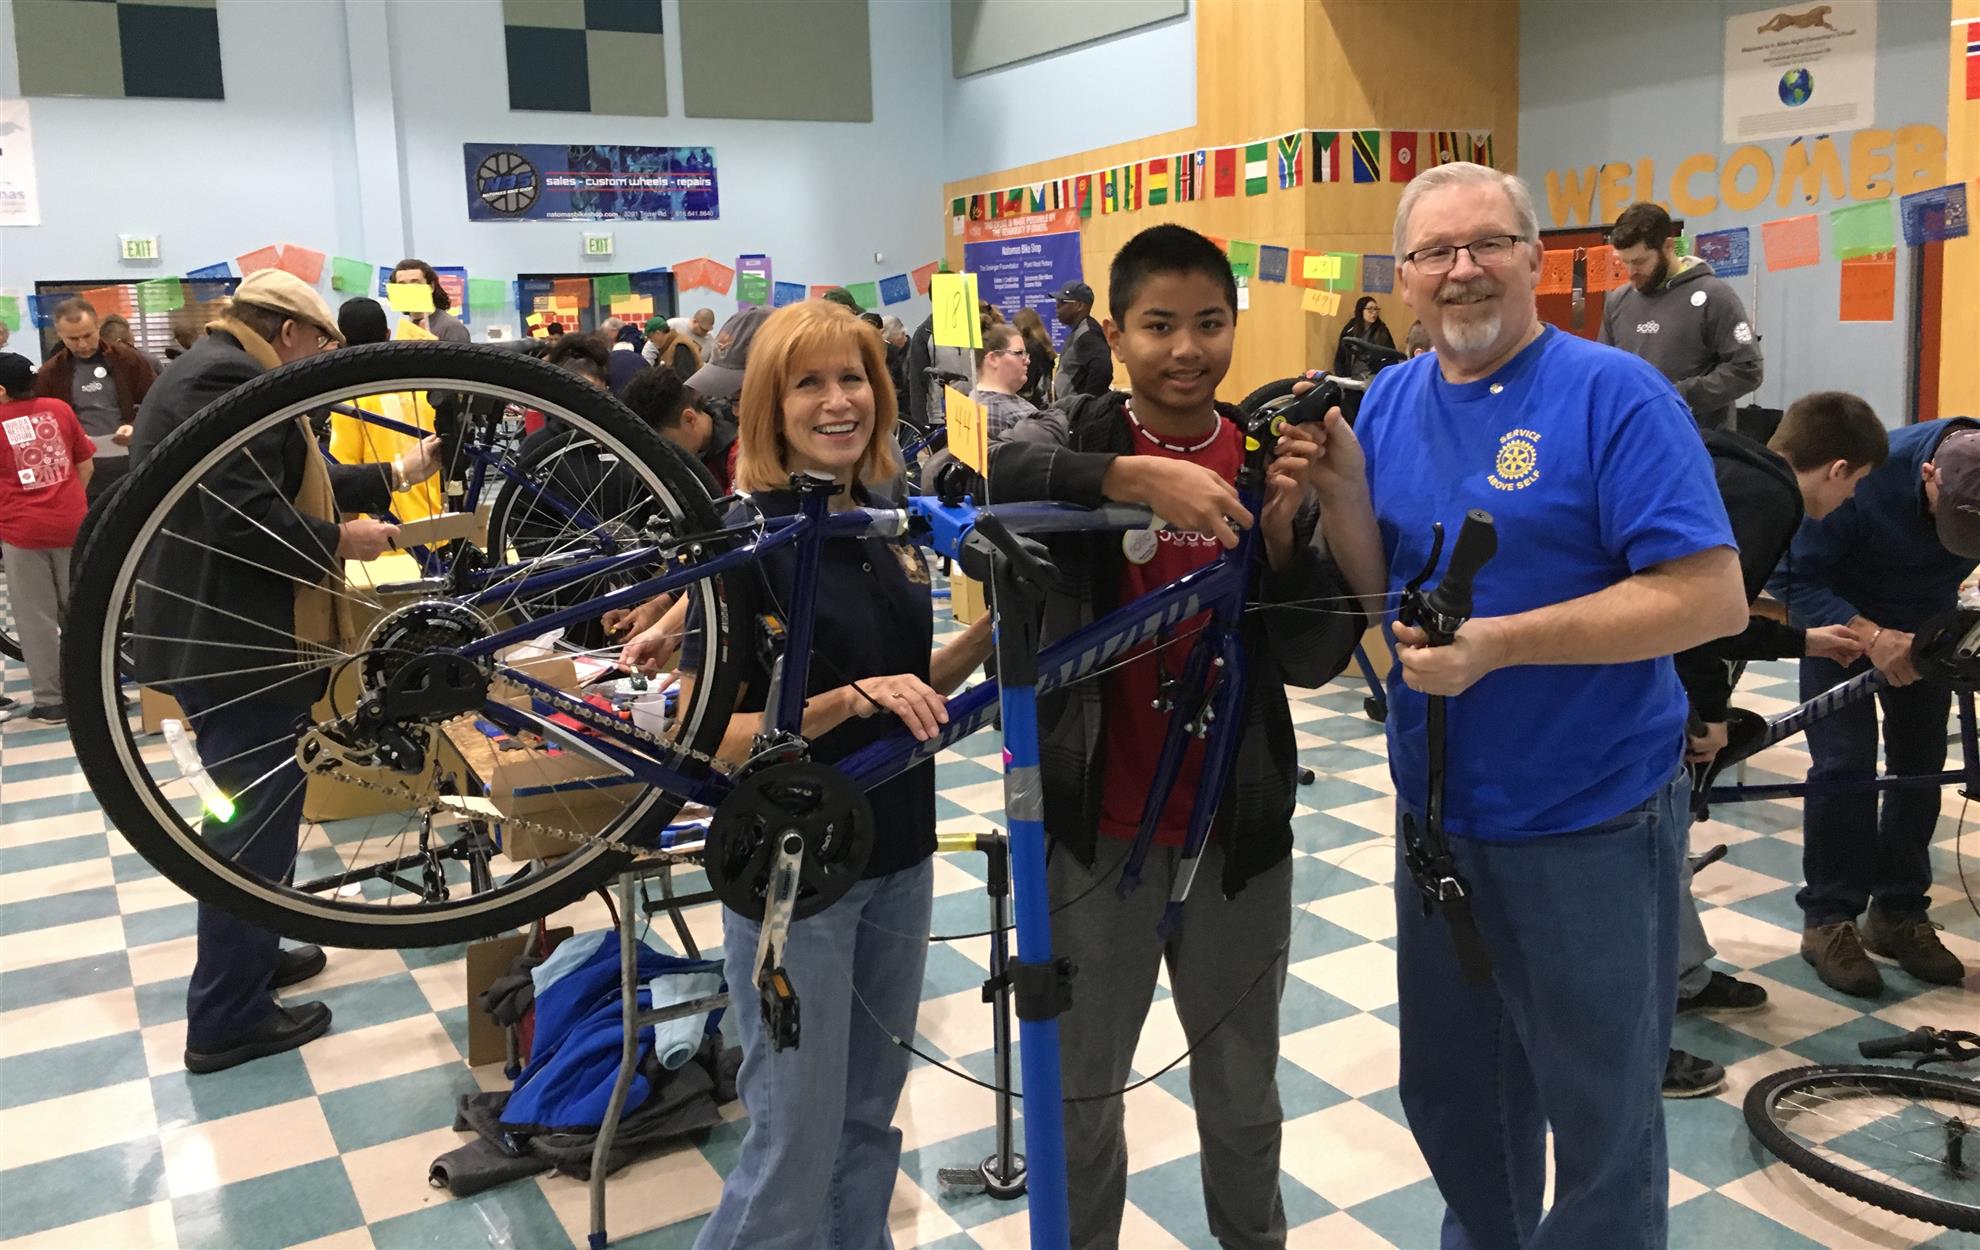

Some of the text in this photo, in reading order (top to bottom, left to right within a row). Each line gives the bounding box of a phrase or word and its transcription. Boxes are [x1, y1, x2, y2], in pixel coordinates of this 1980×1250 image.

[546, 176, 576, 186] sales
[586, 177, 626, 186] custom
[629, 176, 668, 186] wheels
[676, 177, 712, 188] repairs
[127, 240, 152, 257] EXIT
[589, 238, 608, 252] EXIT
[944, 291, 962, 330] 18
[1500, 428, 1542, 444] SERVICE
[35, 458, 70, 484] 2017
[1487, 470, 1540, 490] ABOVE SELF
